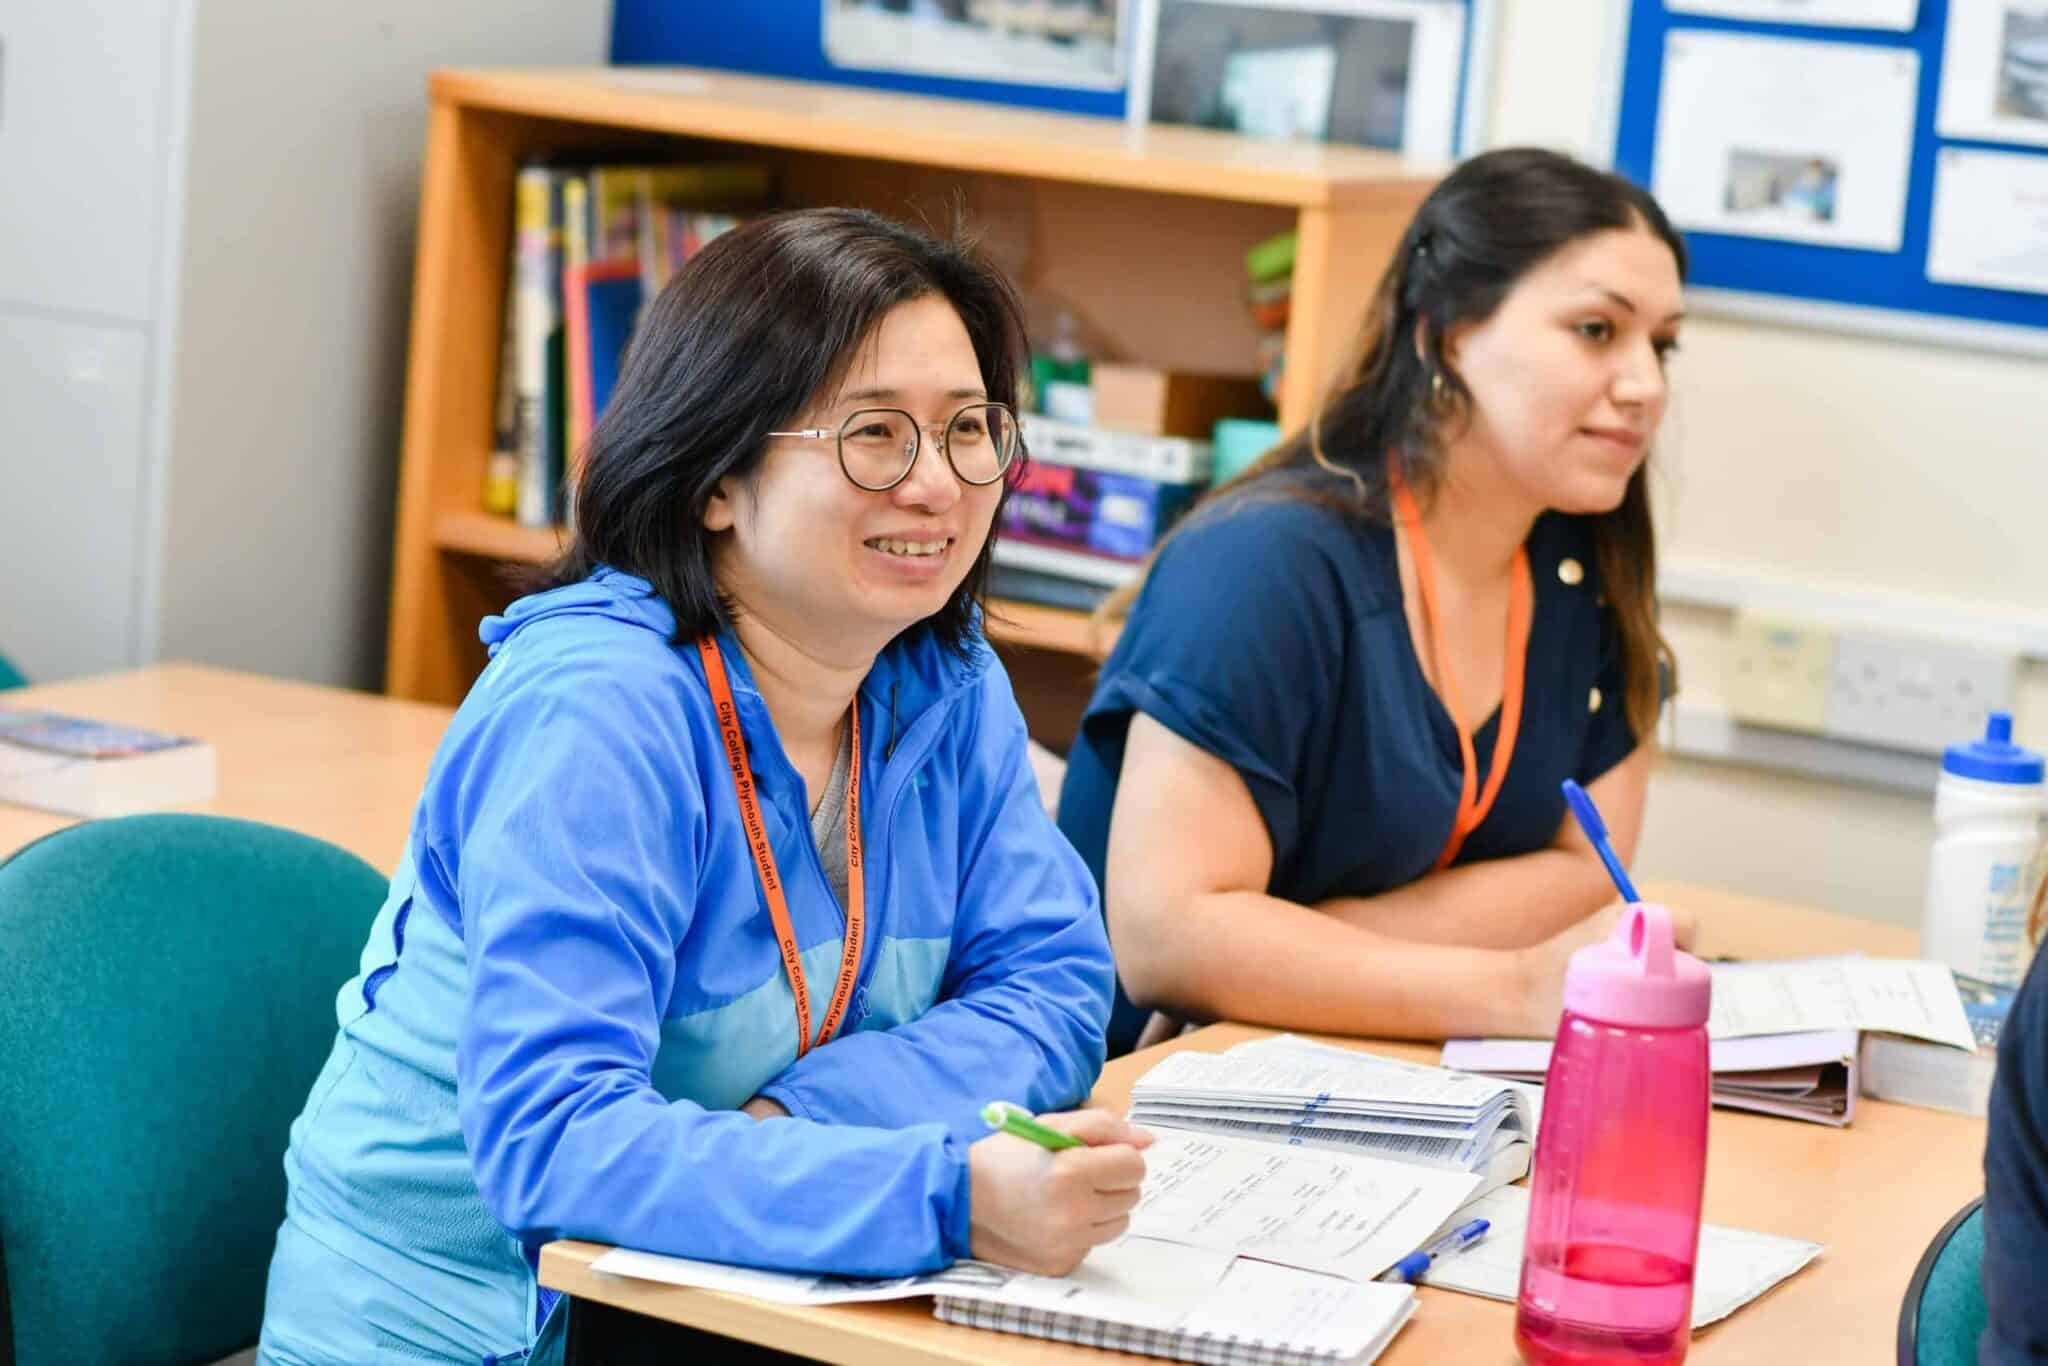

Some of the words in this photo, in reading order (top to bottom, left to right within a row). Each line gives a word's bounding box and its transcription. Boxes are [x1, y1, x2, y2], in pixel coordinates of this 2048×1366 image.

[719, 701, 732, 726] City
[726, 730, 745, 778] College
[740, 780, 761, 839] Plymouth
[757, 842, 777, 890] Student
[850, 844, 859, 867] City
[784, 939, 796, 964] City
[827, 970, 853, 1026] Plymouth
[845, 917, 861, 967] Student
